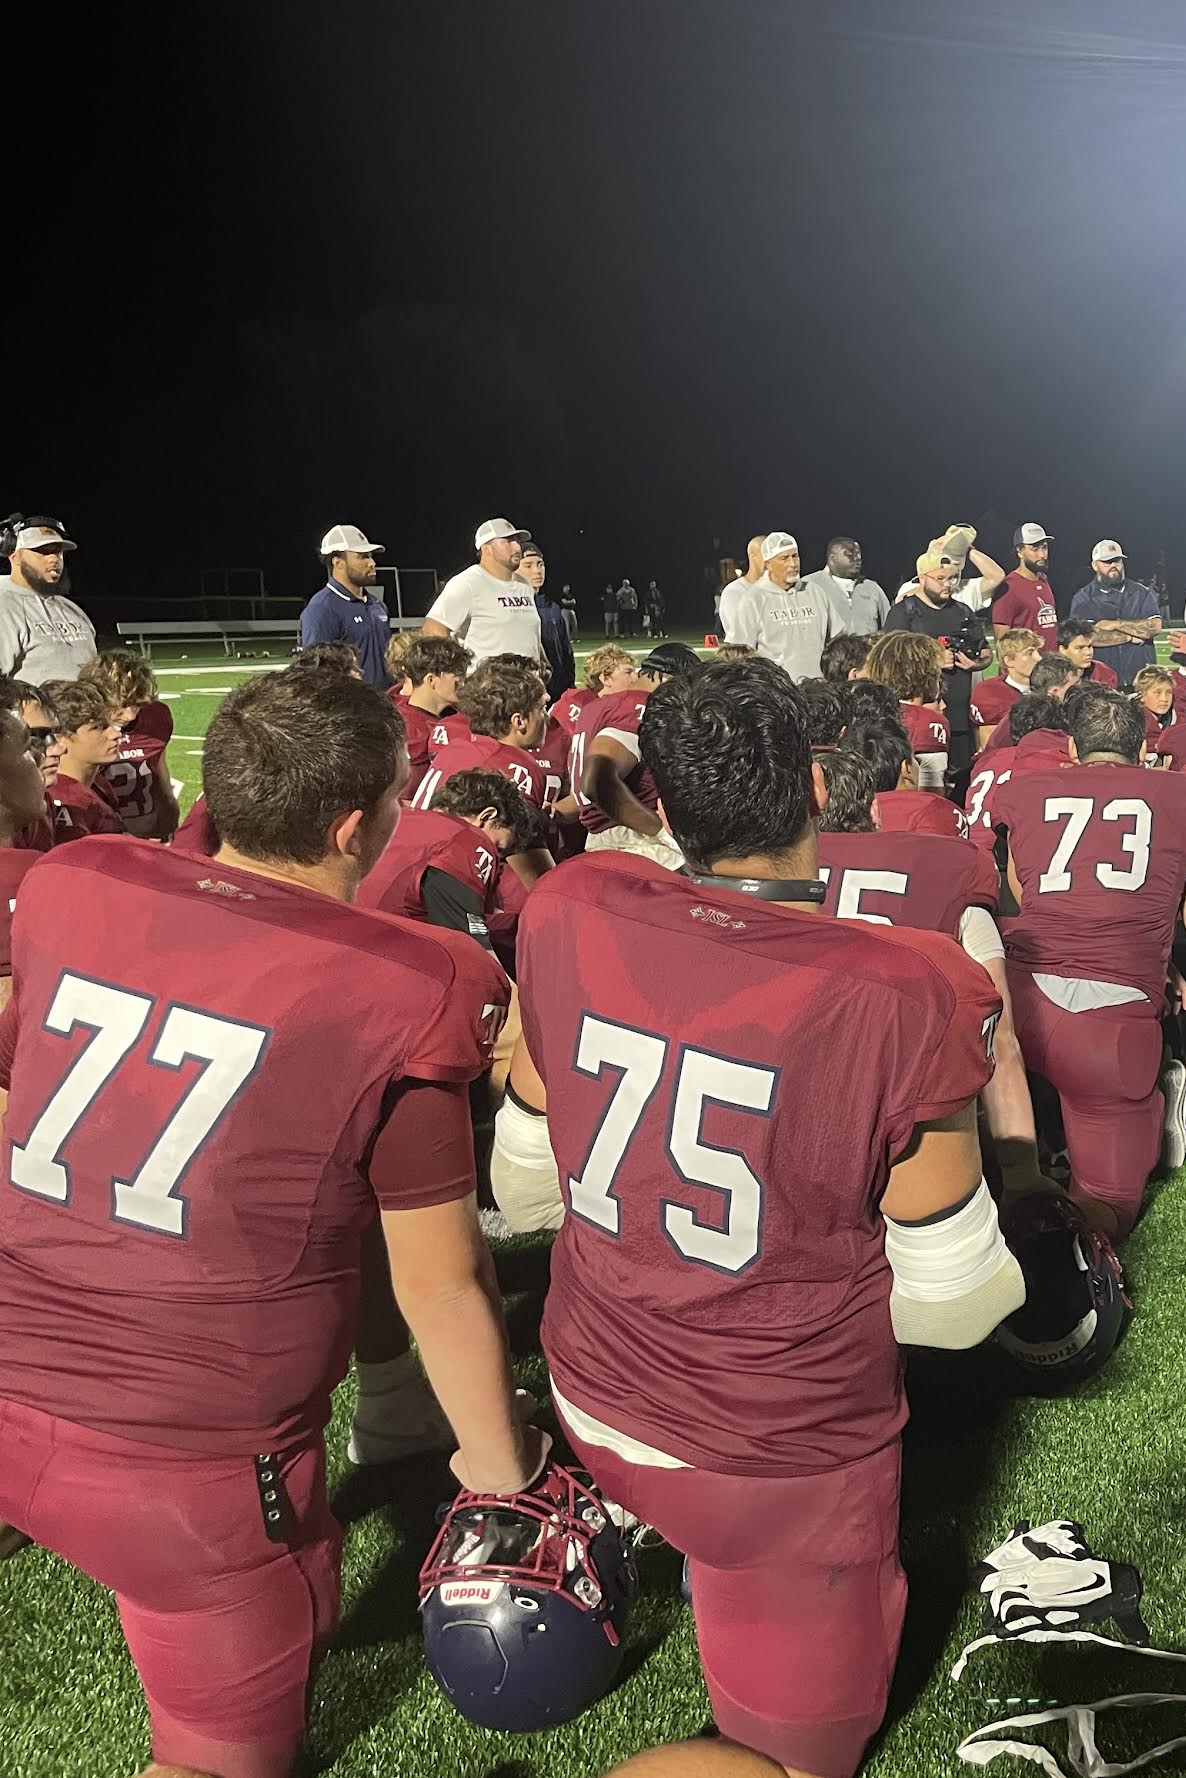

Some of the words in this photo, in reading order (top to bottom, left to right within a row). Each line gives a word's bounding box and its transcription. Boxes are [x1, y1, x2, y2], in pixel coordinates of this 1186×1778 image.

[970, 704, 985, 724] TA
[432, 725, 449, 746] TA
[929, 722, 947, 745] TA
[508, 762, 534, 796] TA
[1038, 797, 1152, 893] 73
[475, 845, 494, 885] TA
[819, 868, 908, 927] 5
[8, 970, 269, 1239] 77
[568, 1012, 777, 1272] 75
[444, 1587, 491, 1601] Riddell
